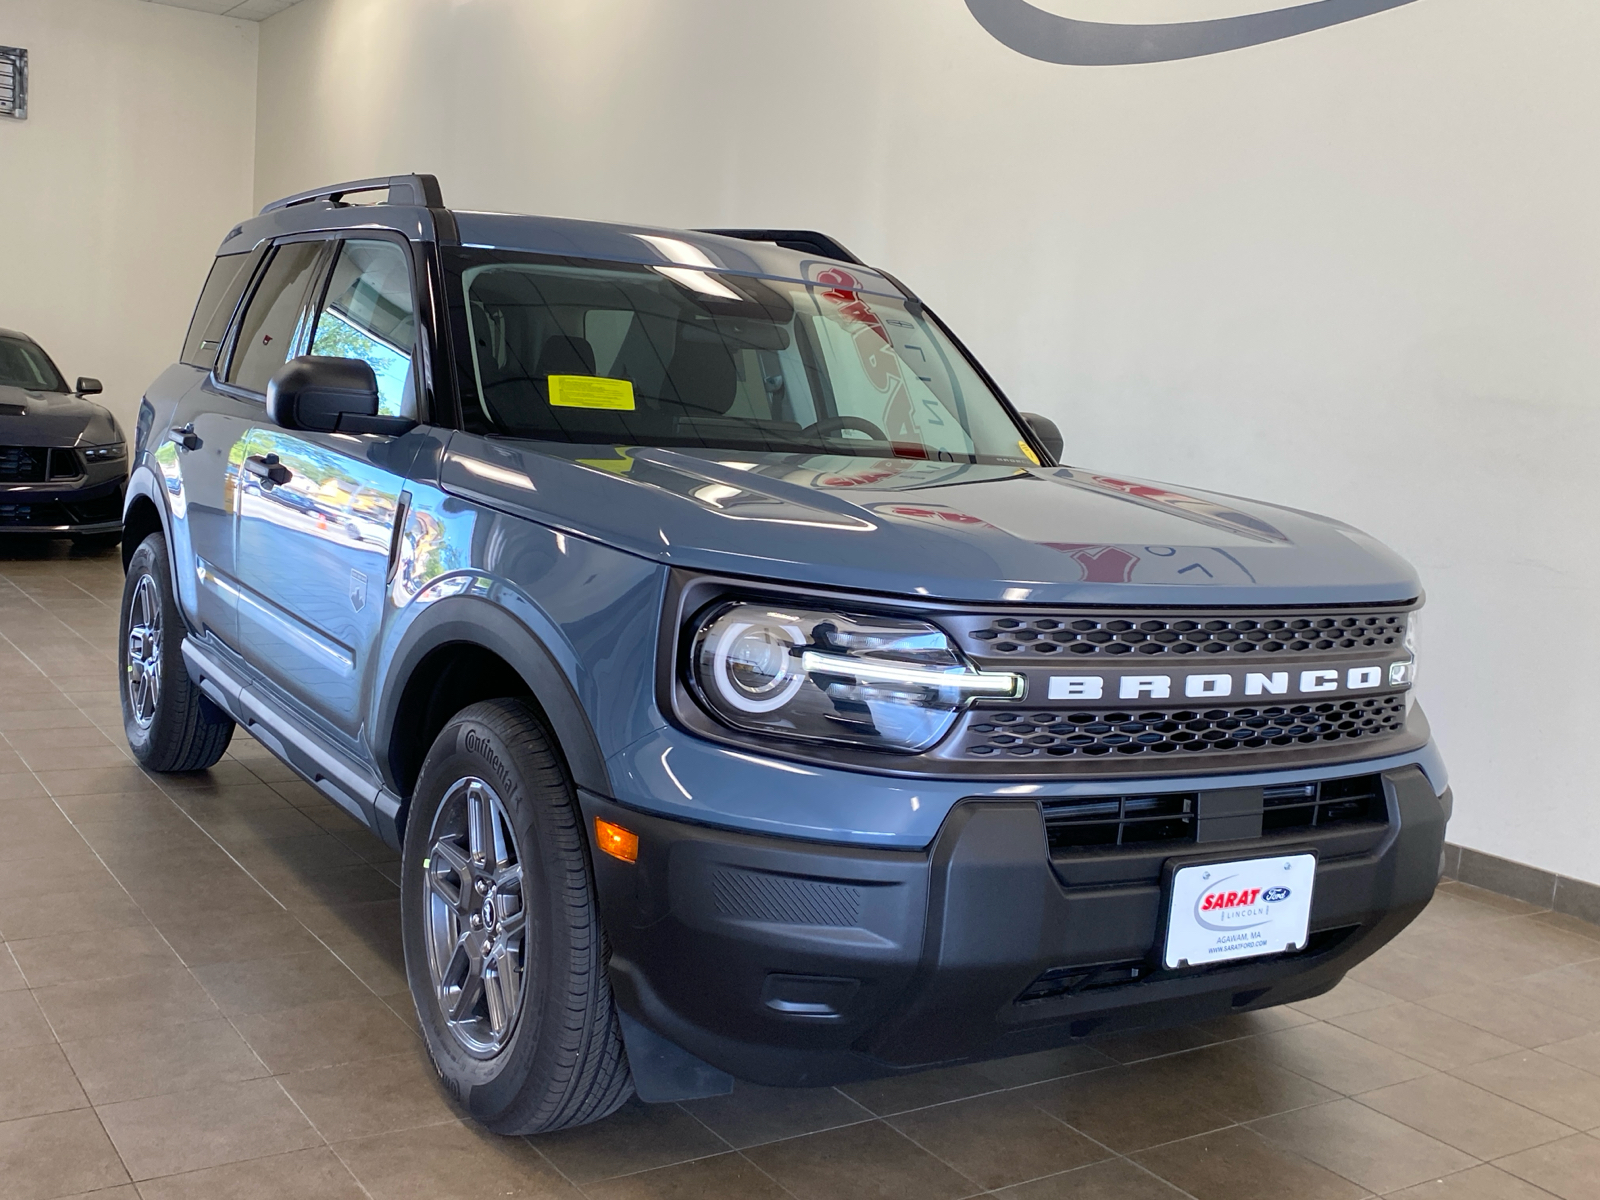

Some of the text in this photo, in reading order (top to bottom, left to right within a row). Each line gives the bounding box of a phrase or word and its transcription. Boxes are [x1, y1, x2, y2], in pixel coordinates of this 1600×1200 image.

[1047, 666, 1381, 700] BRONCO
[465, 729, 518, 797] Continental
[1202, 887, 1288, 911] SARAT Ford
[1227, 908, 1263, 919] LINCOLN
[1208, 940, 1267, 953] WWW.SARATFORD.COM
[1216, 931, 1261, 944] AGAWAM, MA
